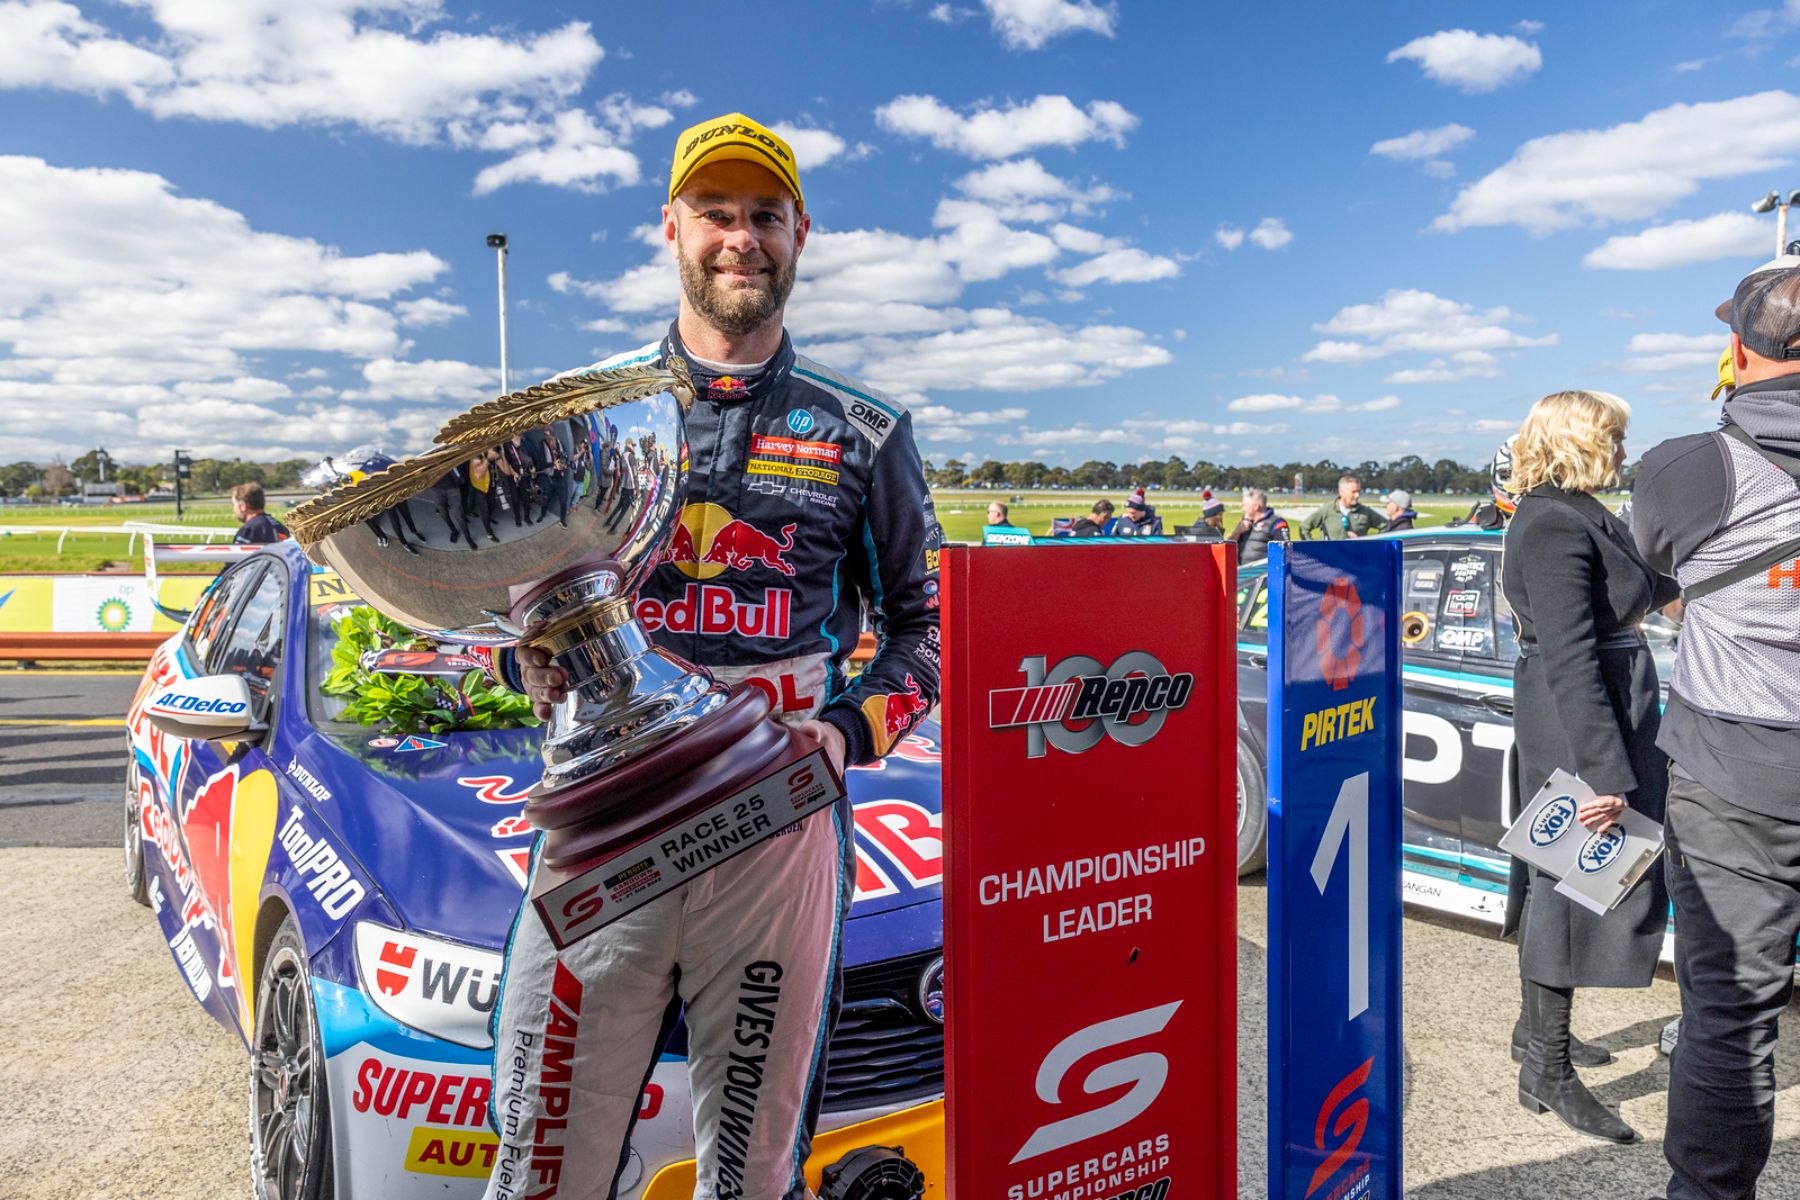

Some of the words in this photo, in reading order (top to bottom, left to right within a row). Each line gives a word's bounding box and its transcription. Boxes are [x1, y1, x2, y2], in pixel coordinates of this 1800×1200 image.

[683, 123, 790, 162] DUNLOP
[790, 411, 811, 430] hp
[851, 404, 889, 430] OMP
[749, 463, 795, 475] NATIONAL
[756, 439, 794, 454] Harvey
[796, 444, 838, 460] Norman
[790, 487, 839, 503] CHEVROLET
[119, 583, 134, 596] bp
[632, 583, 698, 634] ed
[701, 586, 793, 639] Bull
[1441, 629, 1484, 646] OMP
[155, 692, 247, 714] ACDelco
[1017, 650, 1169, 759] 100
[1069, 672, 1194, 724] Repco
[1301, 696, 1377, 752] PIRTEK
[293, 763, 333, 802] DUNLOP
[660, 813, 729, 859] RACE
[733, 794, 765, 821] 25
[672, 813, 772, 873] WINNER
[1534, 803, 1560, 833] SPORTS
[1539, 805, 1572, 839] FOX
[277, 805, 366, 921] ToolPRO
[979, 837, 1206, 906] CHAMPIONSHIP
[1588, 832, 1622, 866] FOX
[1043, 893, 1152, 943] LEADER
[1309, 771, 1369, 1021] 1
[734, 960, 784, 1050] GIVES
[506, 1029, 533, 1137] Premium
[722, 1050, 767, 1113] YOU
[496, 1142, 521, 1200] Fuels
[715, 1106, 753, 1200] WINGS
[1008, 1133, 1169, 1200] SUPERCARS
